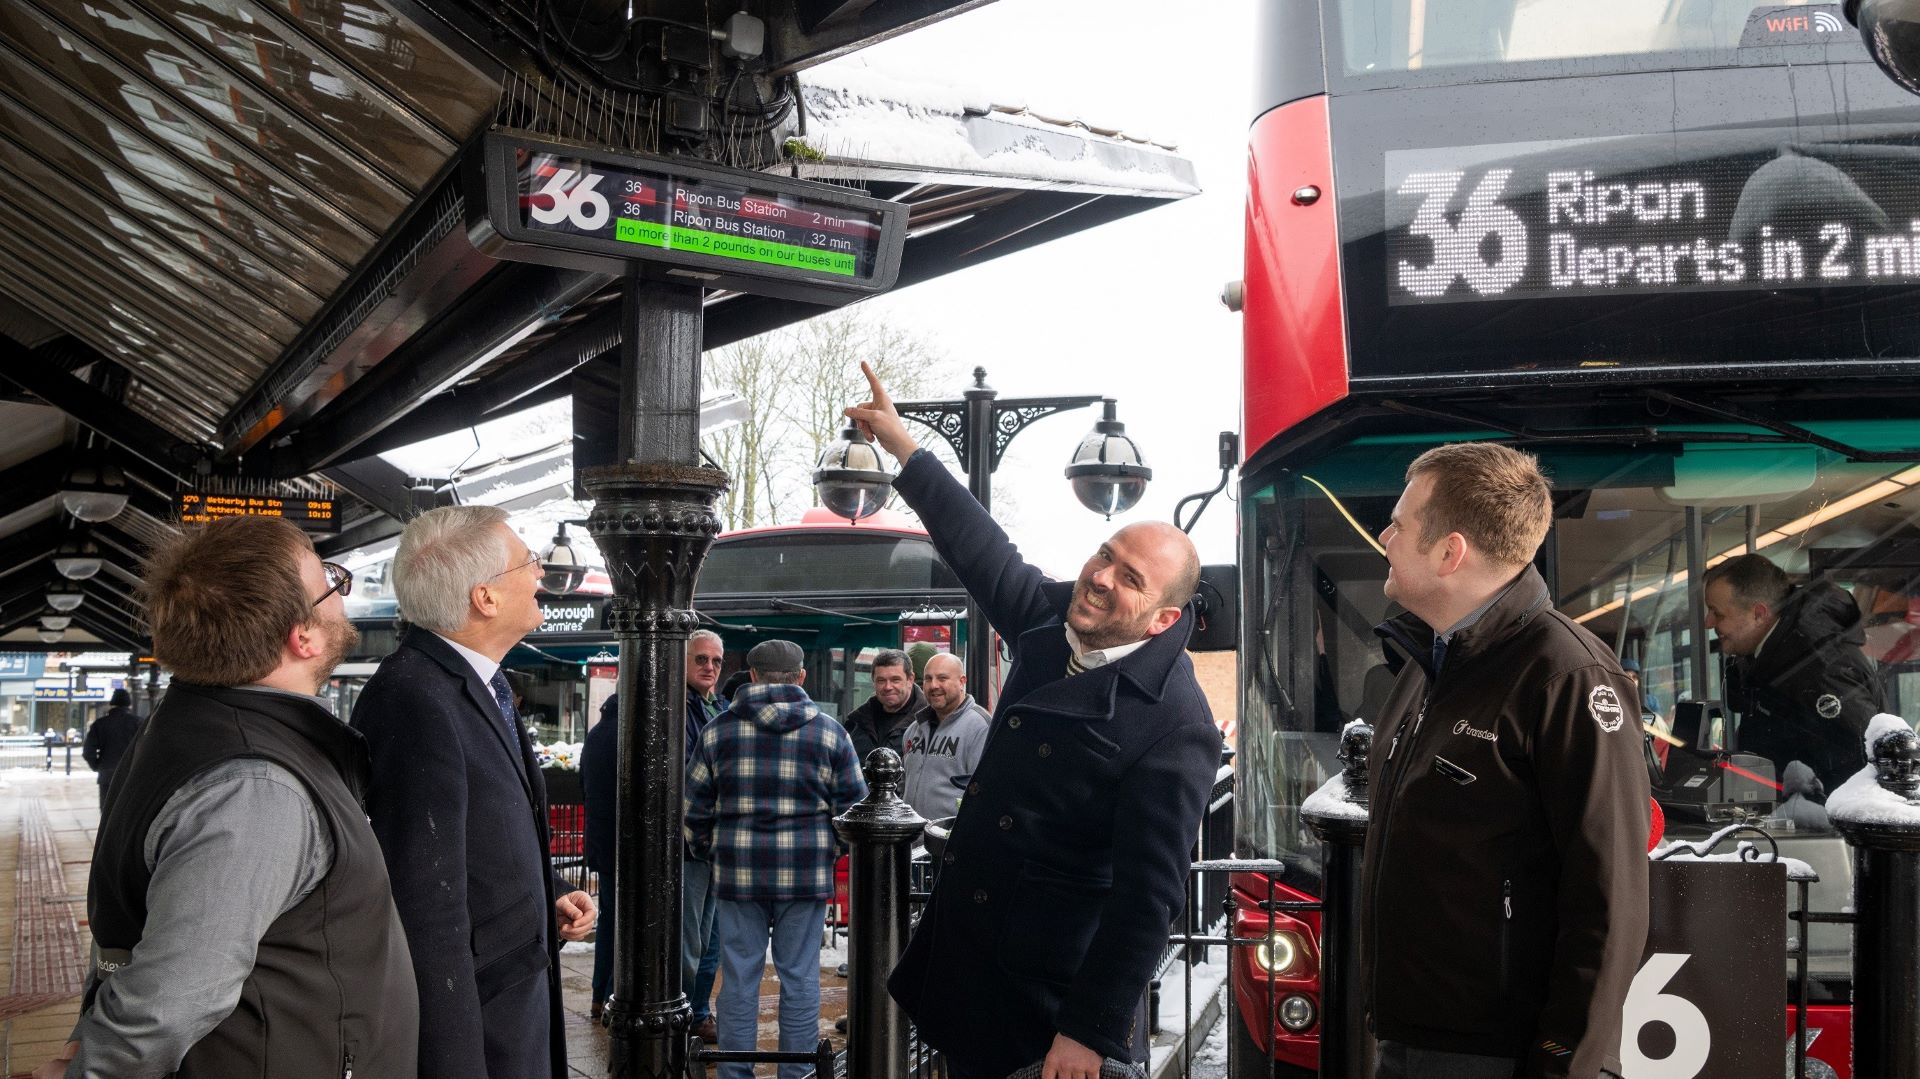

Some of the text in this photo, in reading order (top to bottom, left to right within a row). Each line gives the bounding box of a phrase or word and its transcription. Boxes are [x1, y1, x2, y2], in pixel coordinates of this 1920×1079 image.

[1766, 16, 1809, 32] WiFi
[531, 165, 610, 231] 36
[625, 180, 846, 229] 36 Ripon Bus Station 2 min
[1548, 170, 1705, 225] Ripon
[624, 202, 851, 250] 36 Ripon Bus Station 32 min
[1397, 169, 1527, 297] 36
[619, 224, 635, 237] no
[638, 227, 670, 242] more
[673, 233, 699, 247] than
[702, 236, 711, 248] 2
[713, 239, 756, 256] pounds
[759, 247, 773, 258] on
[776, 250, 794, 261] our
[798, 251, 831, 267] buses
[1548, 232, 1745, 287] Departs
[1762, 226, 1802, 280] in
[1818, 223, 1849, 277] 2
[183, 495, 199, 503] X70
[206, 496, 246, 506] Wetherby
[268, 499, 282, 507] Stn
[206, 506, 246, 515] Wetherby
[258, 508, 282, 516] Leeds
[308, 511, 331, 519] 10:10
[539, 603, 594, 622] borough
[540, 621, 583, 632] Carmires
[911, 628, 919, 637] 7
[1466, 725, 1498, 742] transdev
